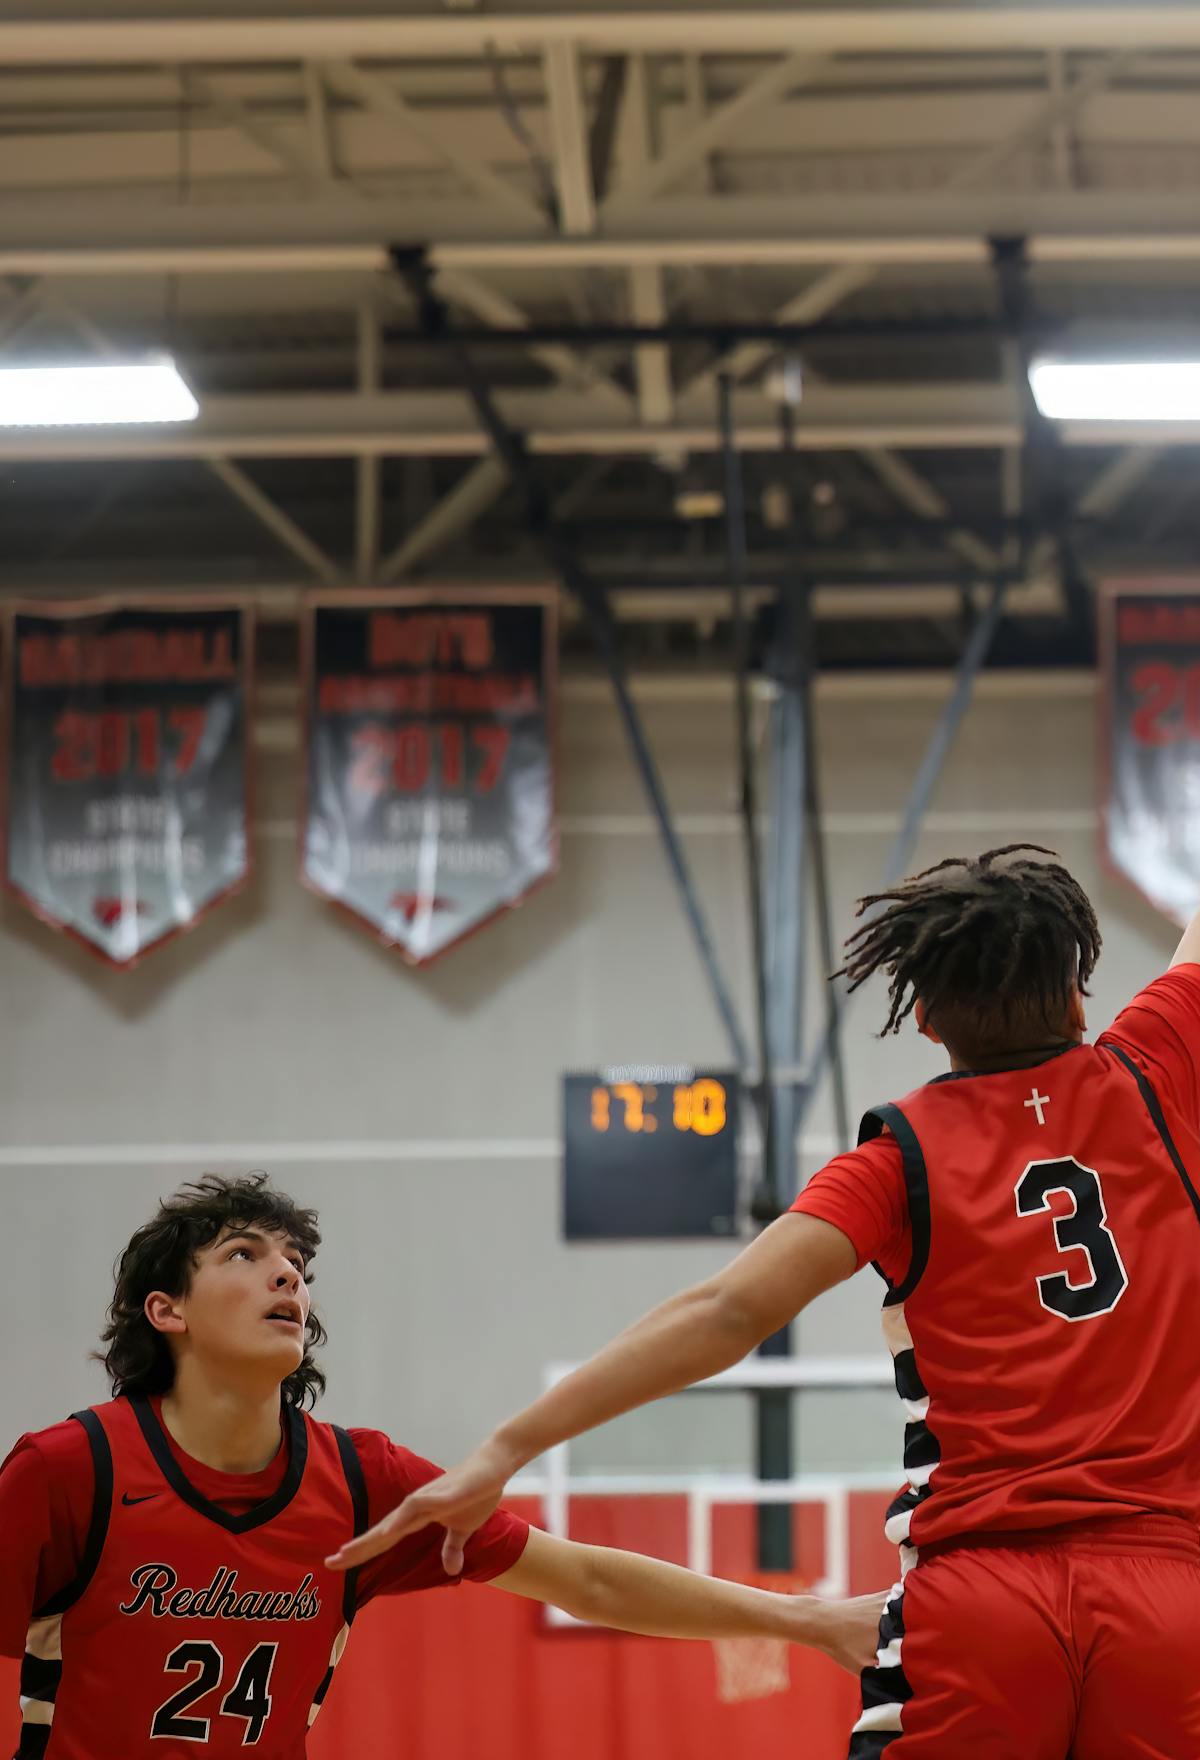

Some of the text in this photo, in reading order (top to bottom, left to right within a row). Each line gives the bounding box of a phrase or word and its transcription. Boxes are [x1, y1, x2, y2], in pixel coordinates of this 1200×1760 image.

[53, 706, 208, 781] 2017
[351, 723, 510, 795] 2017
[1013, 1155, 1129, 1323] 3
[119, 1562, 321, 1621] Redhawks
[149, 1639, 279, 1746] 24
